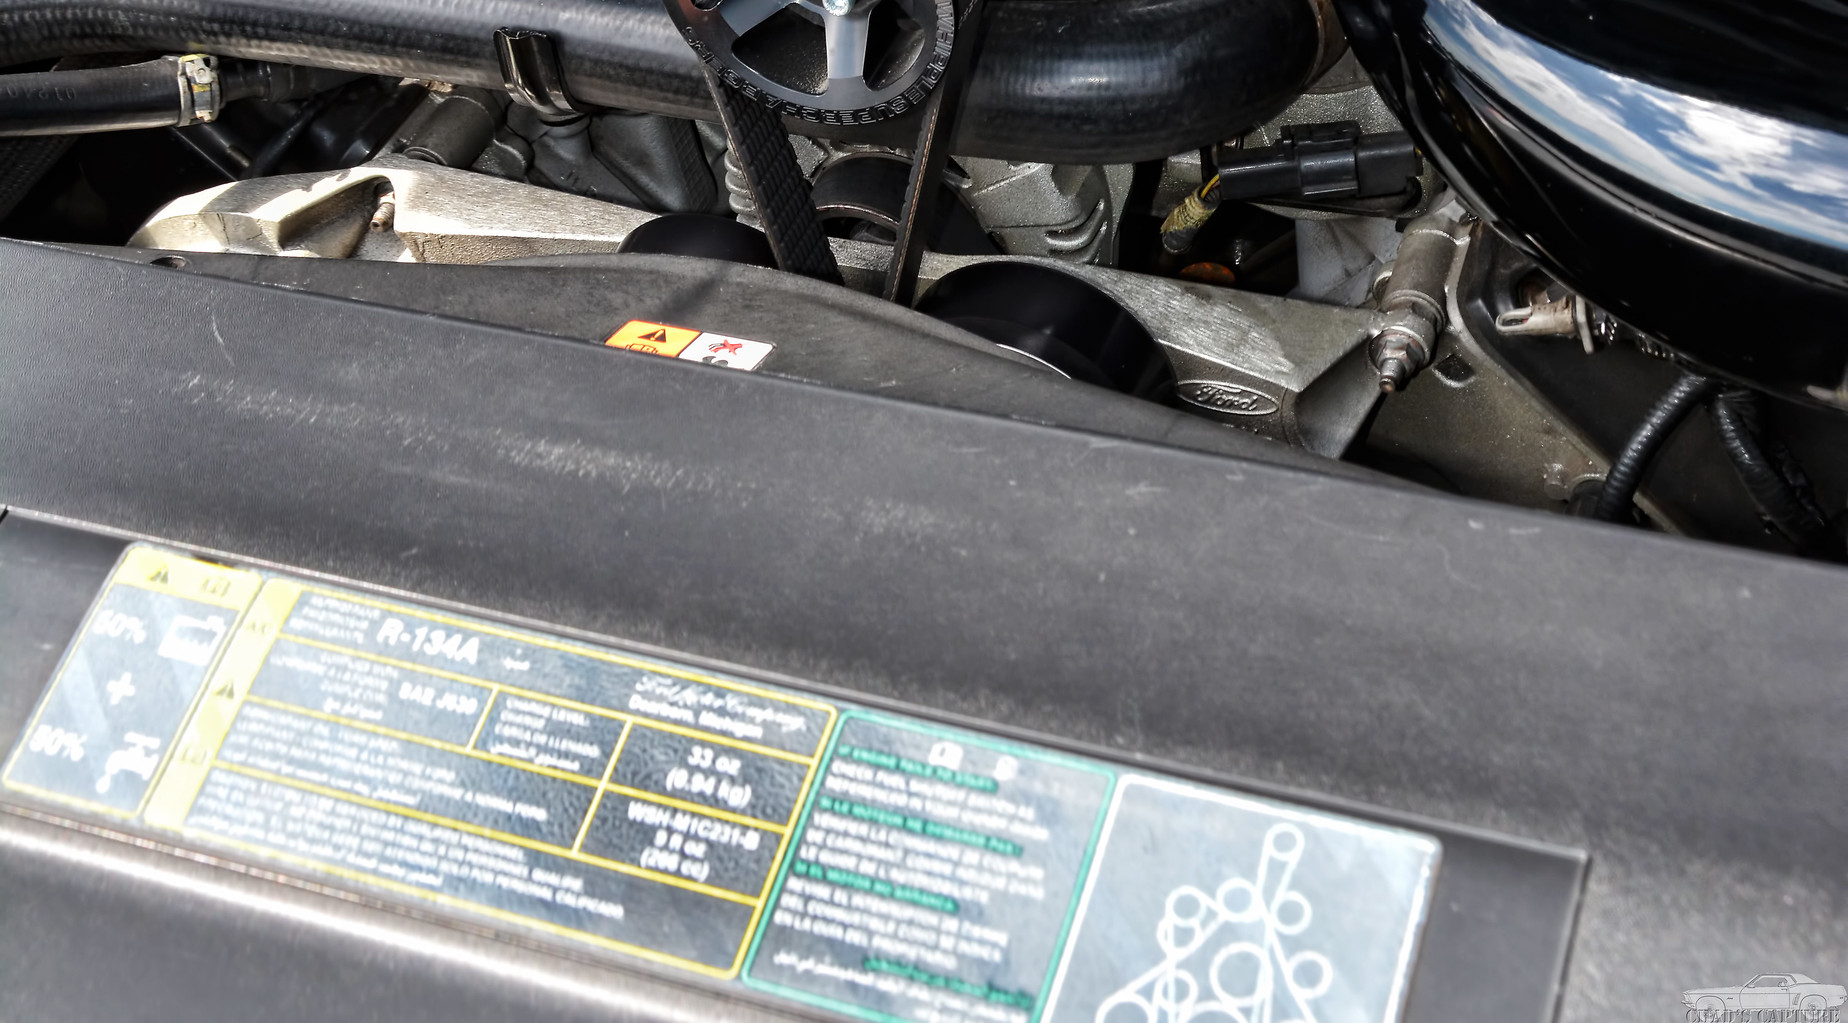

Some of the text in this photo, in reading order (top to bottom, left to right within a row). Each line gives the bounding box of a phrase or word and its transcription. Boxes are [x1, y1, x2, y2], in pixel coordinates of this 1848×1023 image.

[1195, 383, 1258, 412] Ford
[375, 617, 481, 666] R-134A
[686, 744, 742, 777] 33 oz
